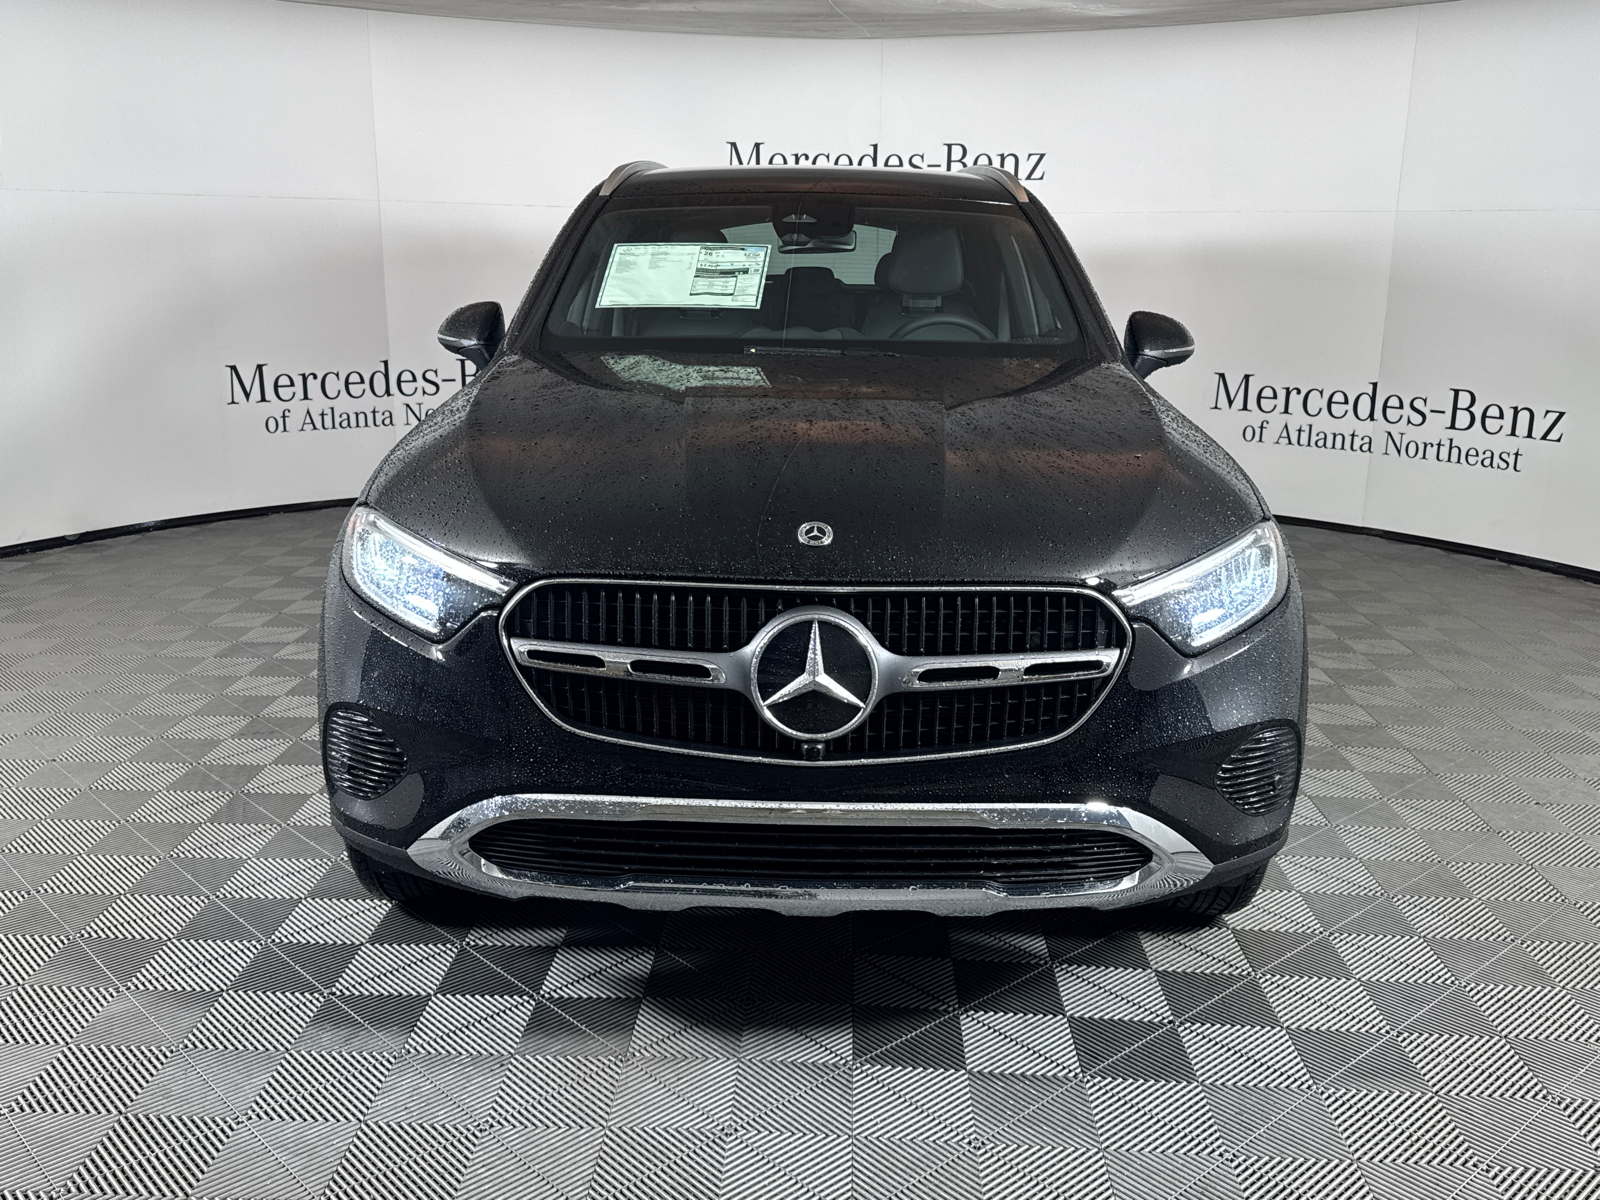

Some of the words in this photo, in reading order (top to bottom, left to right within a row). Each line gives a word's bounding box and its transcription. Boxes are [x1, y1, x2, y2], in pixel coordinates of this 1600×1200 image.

[225, 358, 480, 405] Mercedes-
[265, 408, 291, 434] of
[298, 406, 394, 432] Atlanta
[1210, 372, 1567, 443] Mercedes-Benz
[1242, 419, 1269, 443] of
[1274, 421, 1373, 454] Atlanta
[1383, 430, 1523, 472] Northeast
